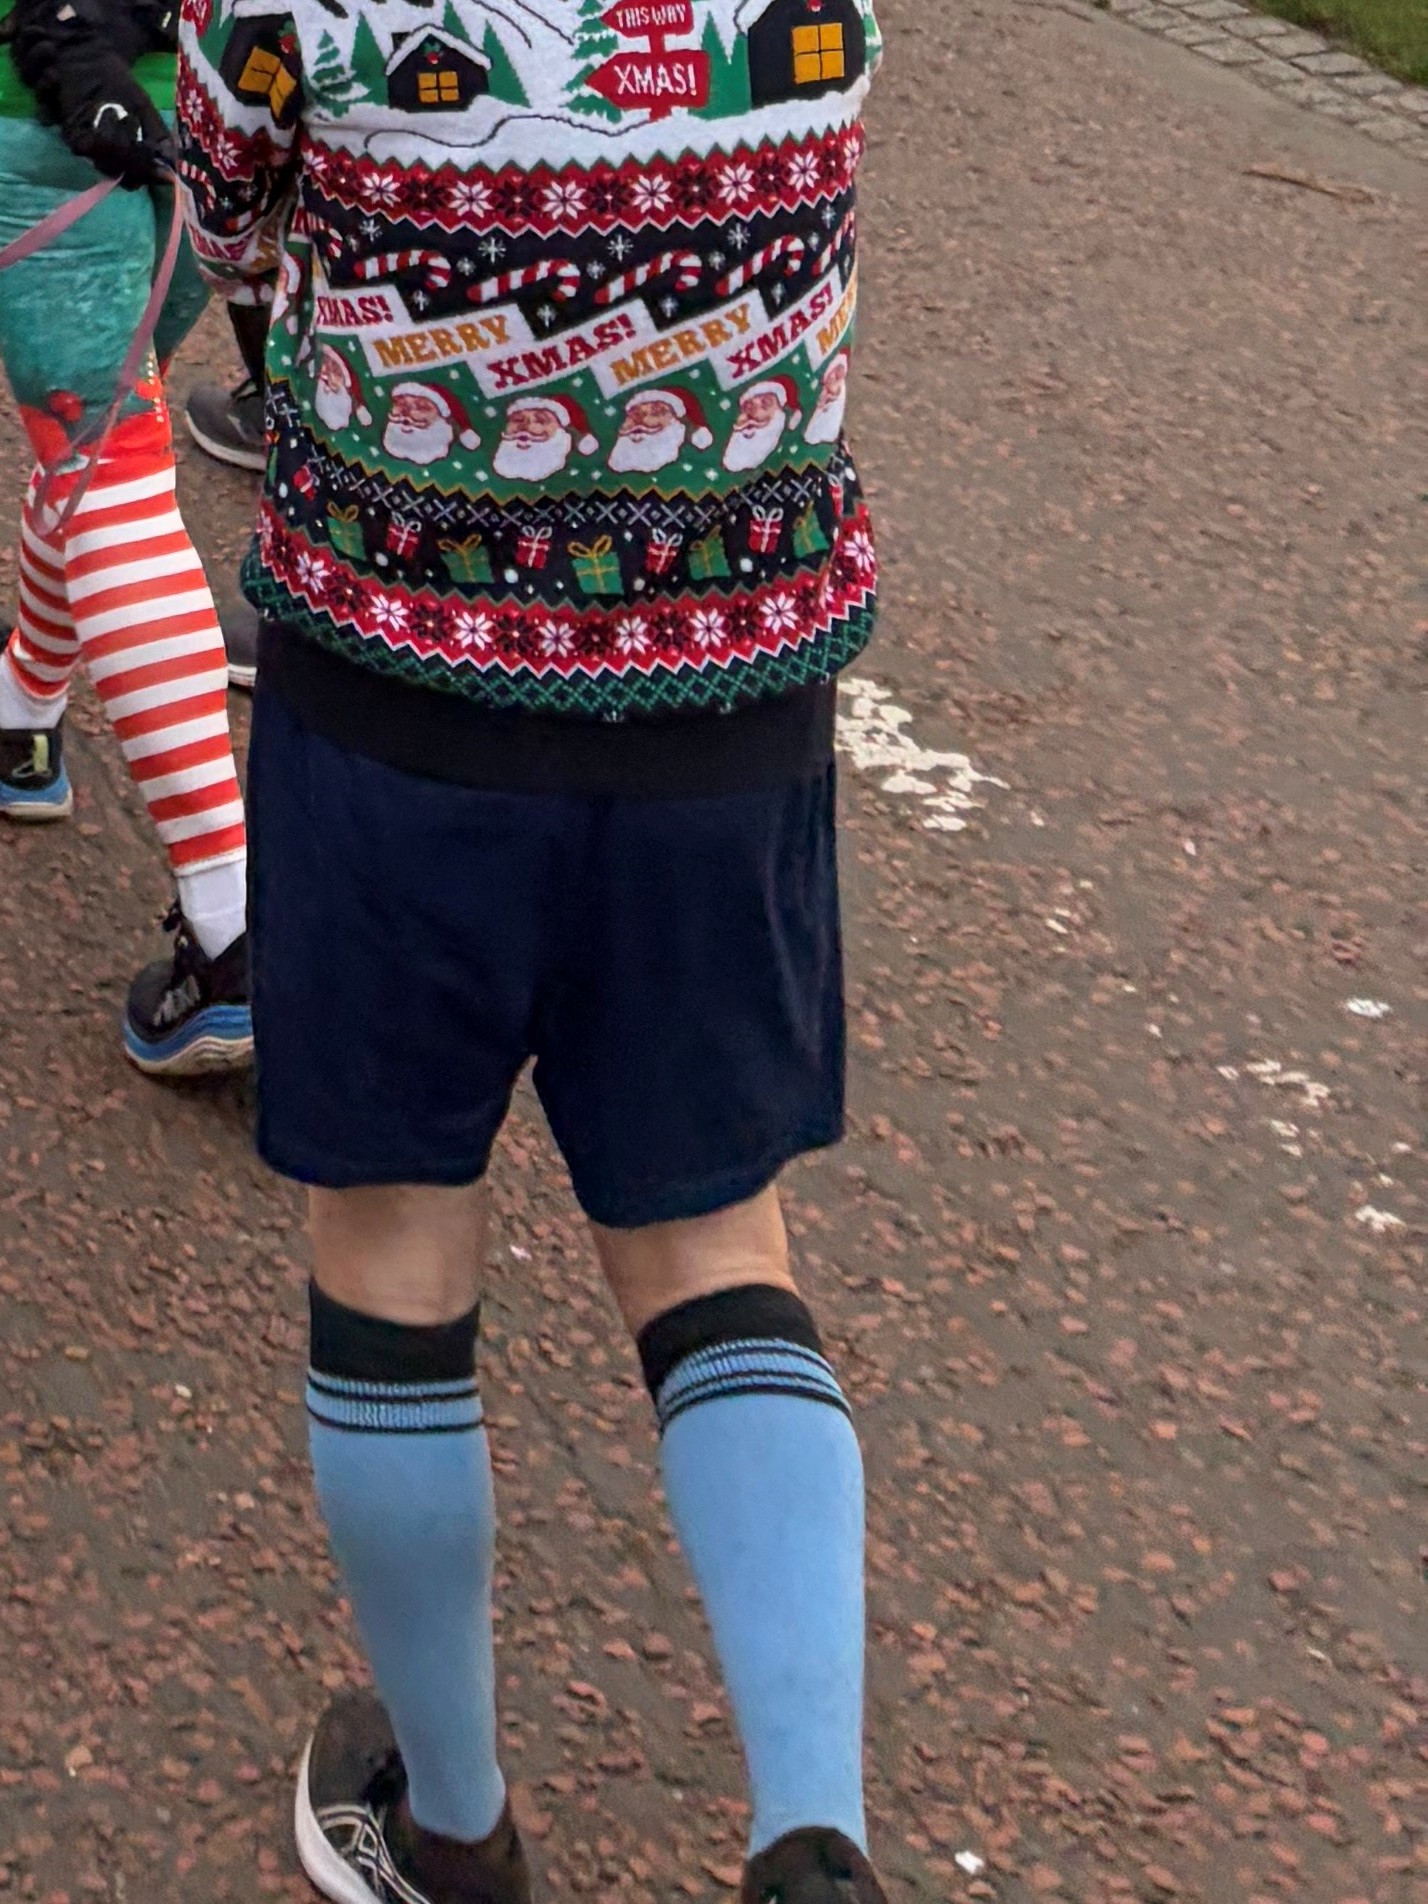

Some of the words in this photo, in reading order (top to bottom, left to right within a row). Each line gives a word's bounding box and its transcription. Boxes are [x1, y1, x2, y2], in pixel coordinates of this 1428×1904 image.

[615, 6, 650, 28] THIS
[650, 3, 686, 25] WAY
[613, 62, 697, 96] XMAS!
[316, 295, 394, 326] XMAS!
[373, 314, 510, 368] MERRY
[487, 313, 636, 390] XMAS!
[610, 303, 751, 387] MERRY
[726, 282, 834, 380] XMAS!
